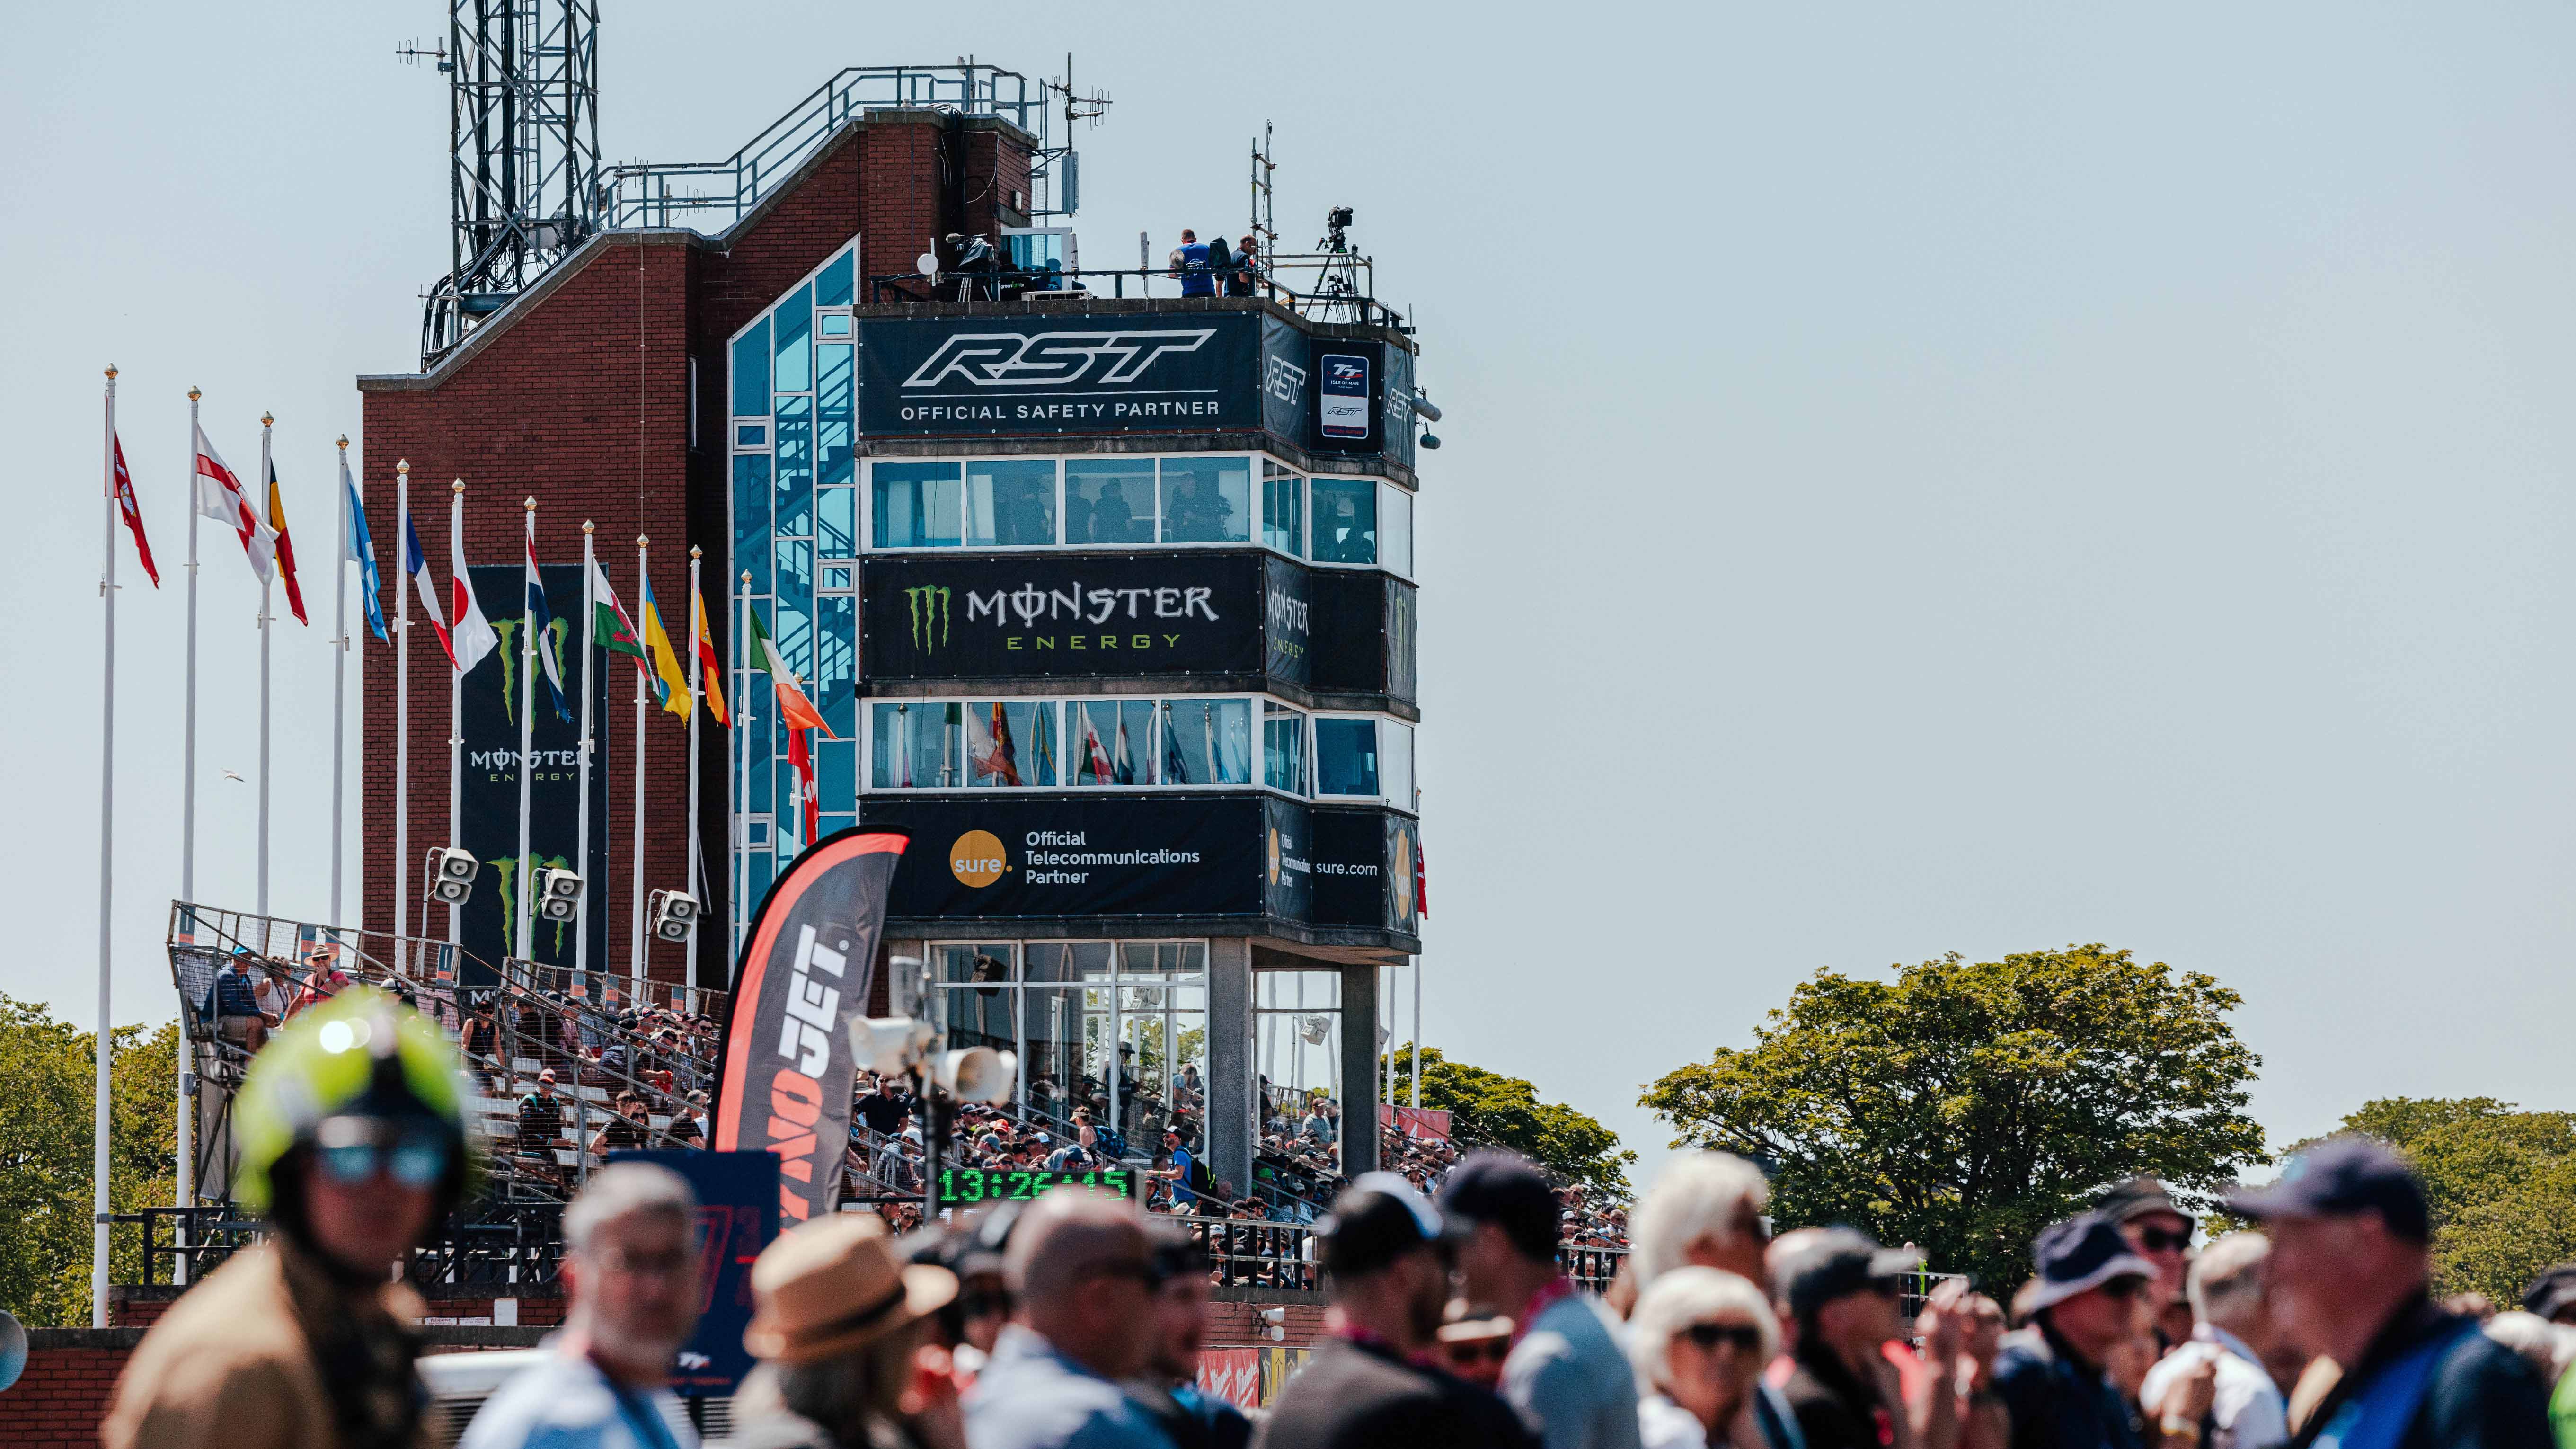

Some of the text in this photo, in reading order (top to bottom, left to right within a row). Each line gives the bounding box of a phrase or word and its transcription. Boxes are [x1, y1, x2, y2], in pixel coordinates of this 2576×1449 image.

[901, 329, 1217, 387] RST
[1266, 354, 1306, 405] RST
[901, 401, 1218, 420] OFFICIAL SAFETY PARTNER
[1327, 407, 1363, 416] RST
[966, 581, 1220, 628] MONSTER
[1007, 634, 1180, 650] ENERGY
[490, 773, 574, 781] ENRGY
[1026, 831, 1086, 846] Official
[1025, 849, 1200, 865] Telecommunications
[1026, 870, 1089, 884] Partner
[1317, 863, 1377, 876] sure.com
[767, 924, 849, 1238] YNOJET
